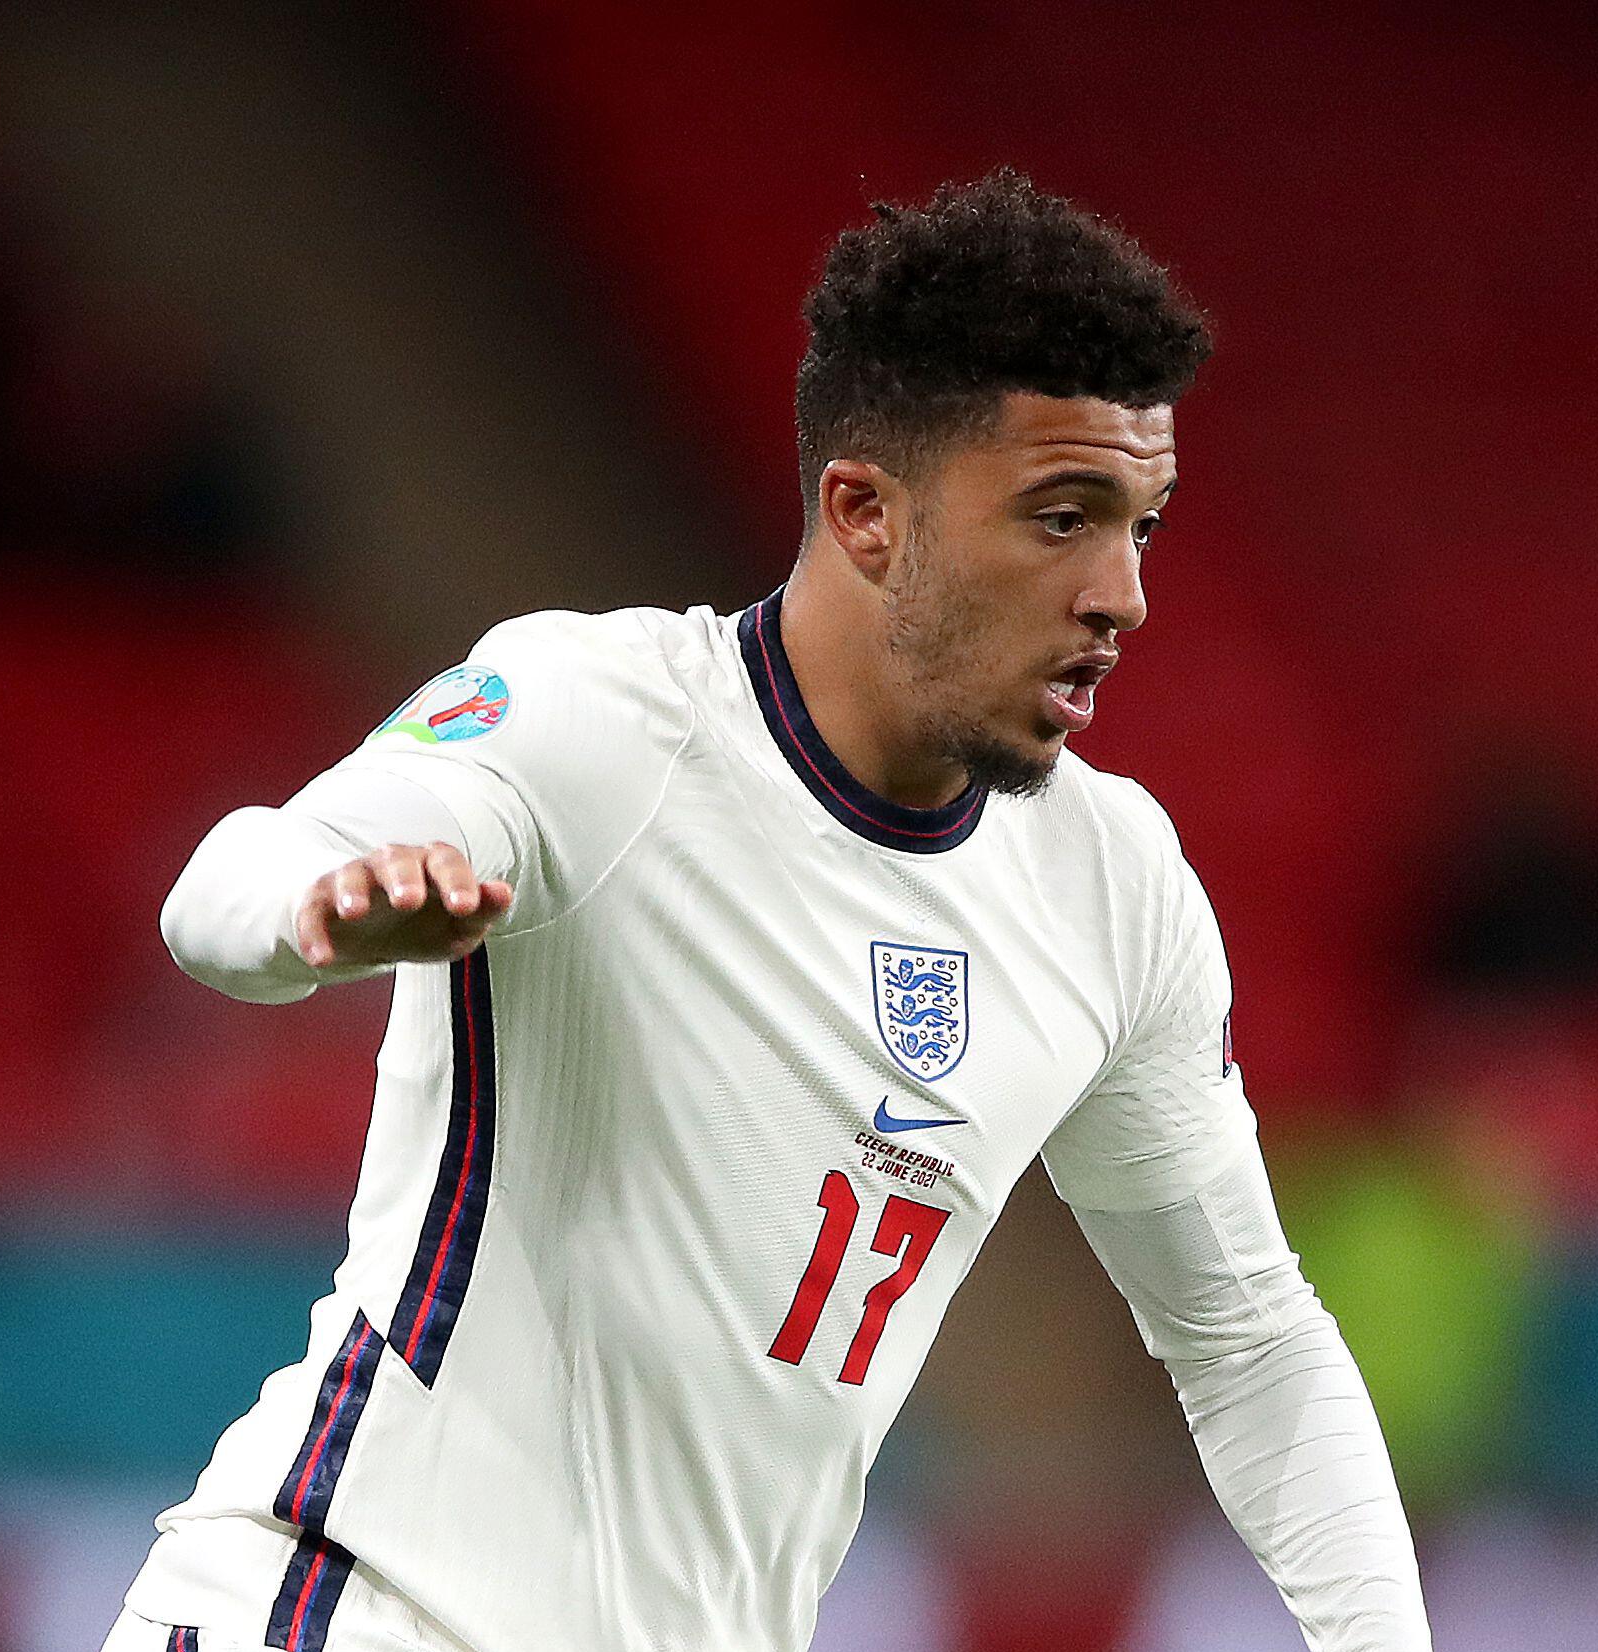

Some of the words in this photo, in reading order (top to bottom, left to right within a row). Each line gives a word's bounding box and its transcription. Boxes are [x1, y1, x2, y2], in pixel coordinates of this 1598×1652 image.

[854, 1132, 898, 1157] CZECH
[896, 1148, 955, 1177] REPUBLIC
[861, 1151, 876, 1169] 22
[877, 1159, 911, 1180] JUNE
[910, 1169, 938, 1188] 2021
[767, 1169, 952, 1386] 17
